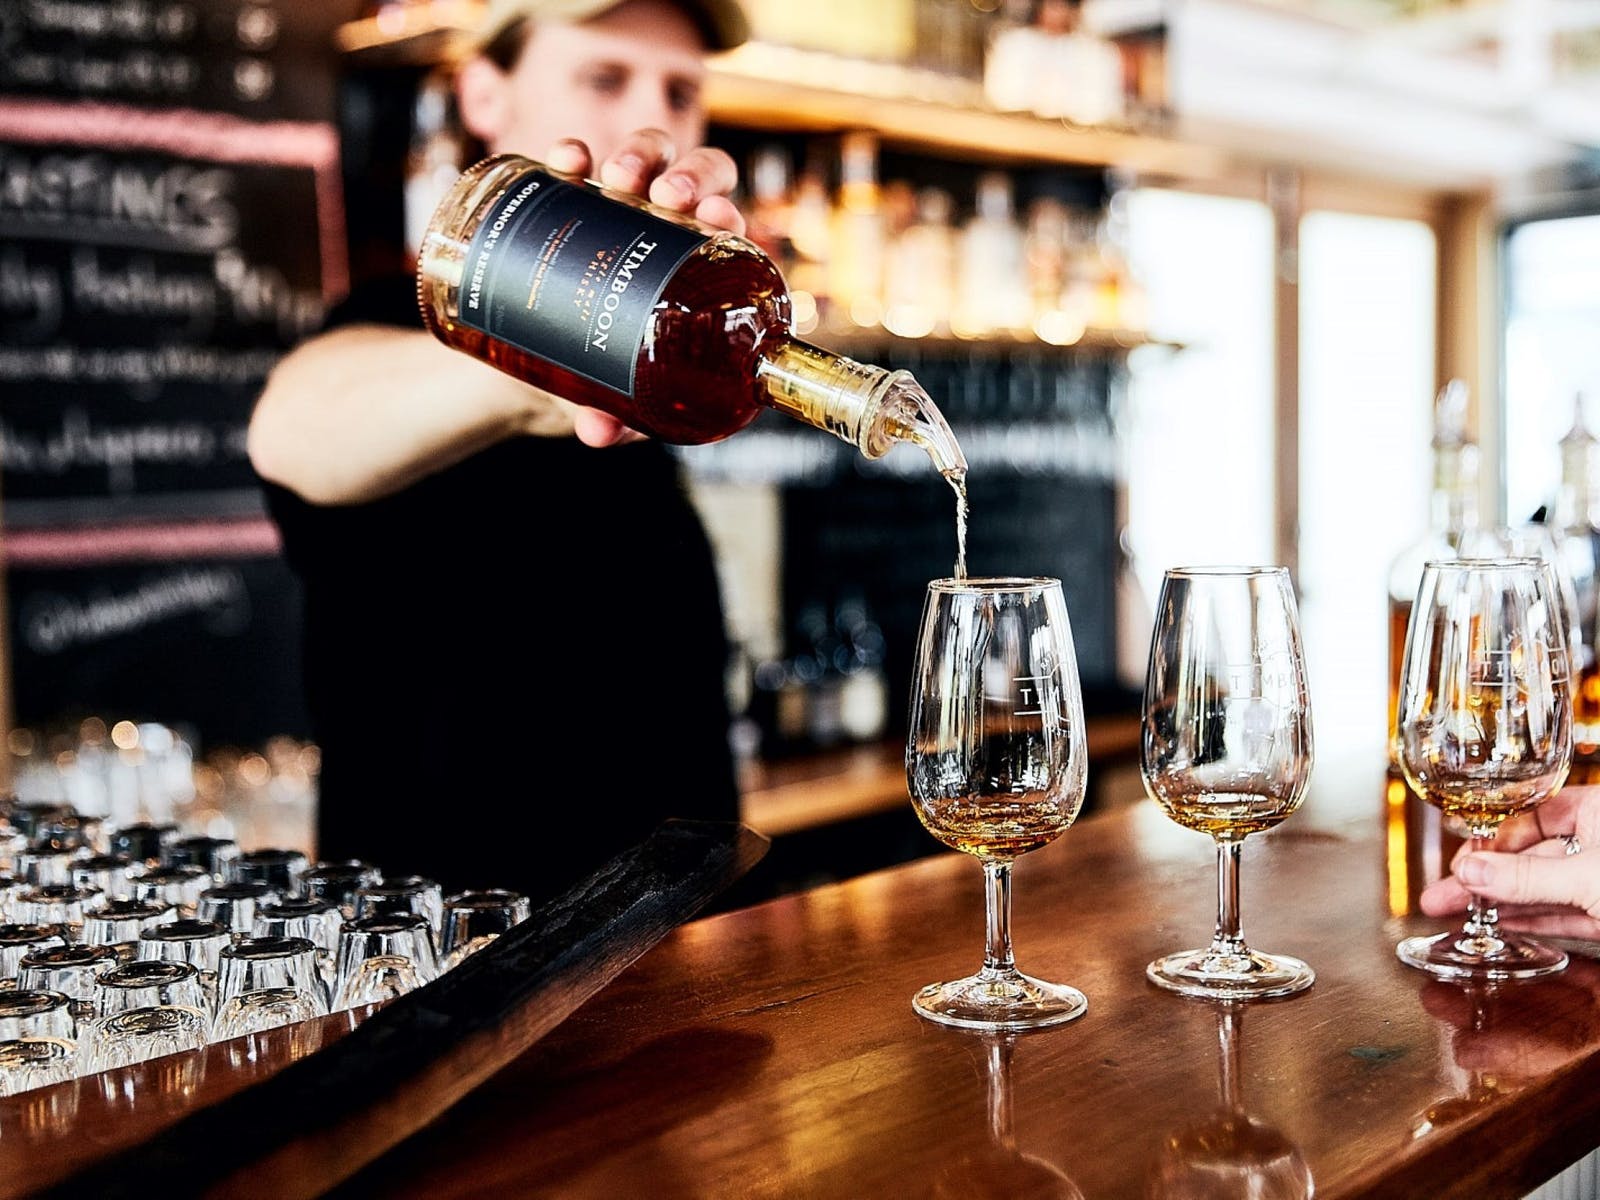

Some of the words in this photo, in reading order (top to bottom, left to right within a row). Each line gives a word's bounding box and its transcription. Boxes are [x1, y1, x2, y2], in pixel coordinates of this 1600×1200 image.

[487, 181, 540, 250] GOVERNOR'S
[468, 250, 491, 310] RESERVE
[574, 250, 606, 308] WHISKY
[592, 241, 658, 352] TIMBOON
